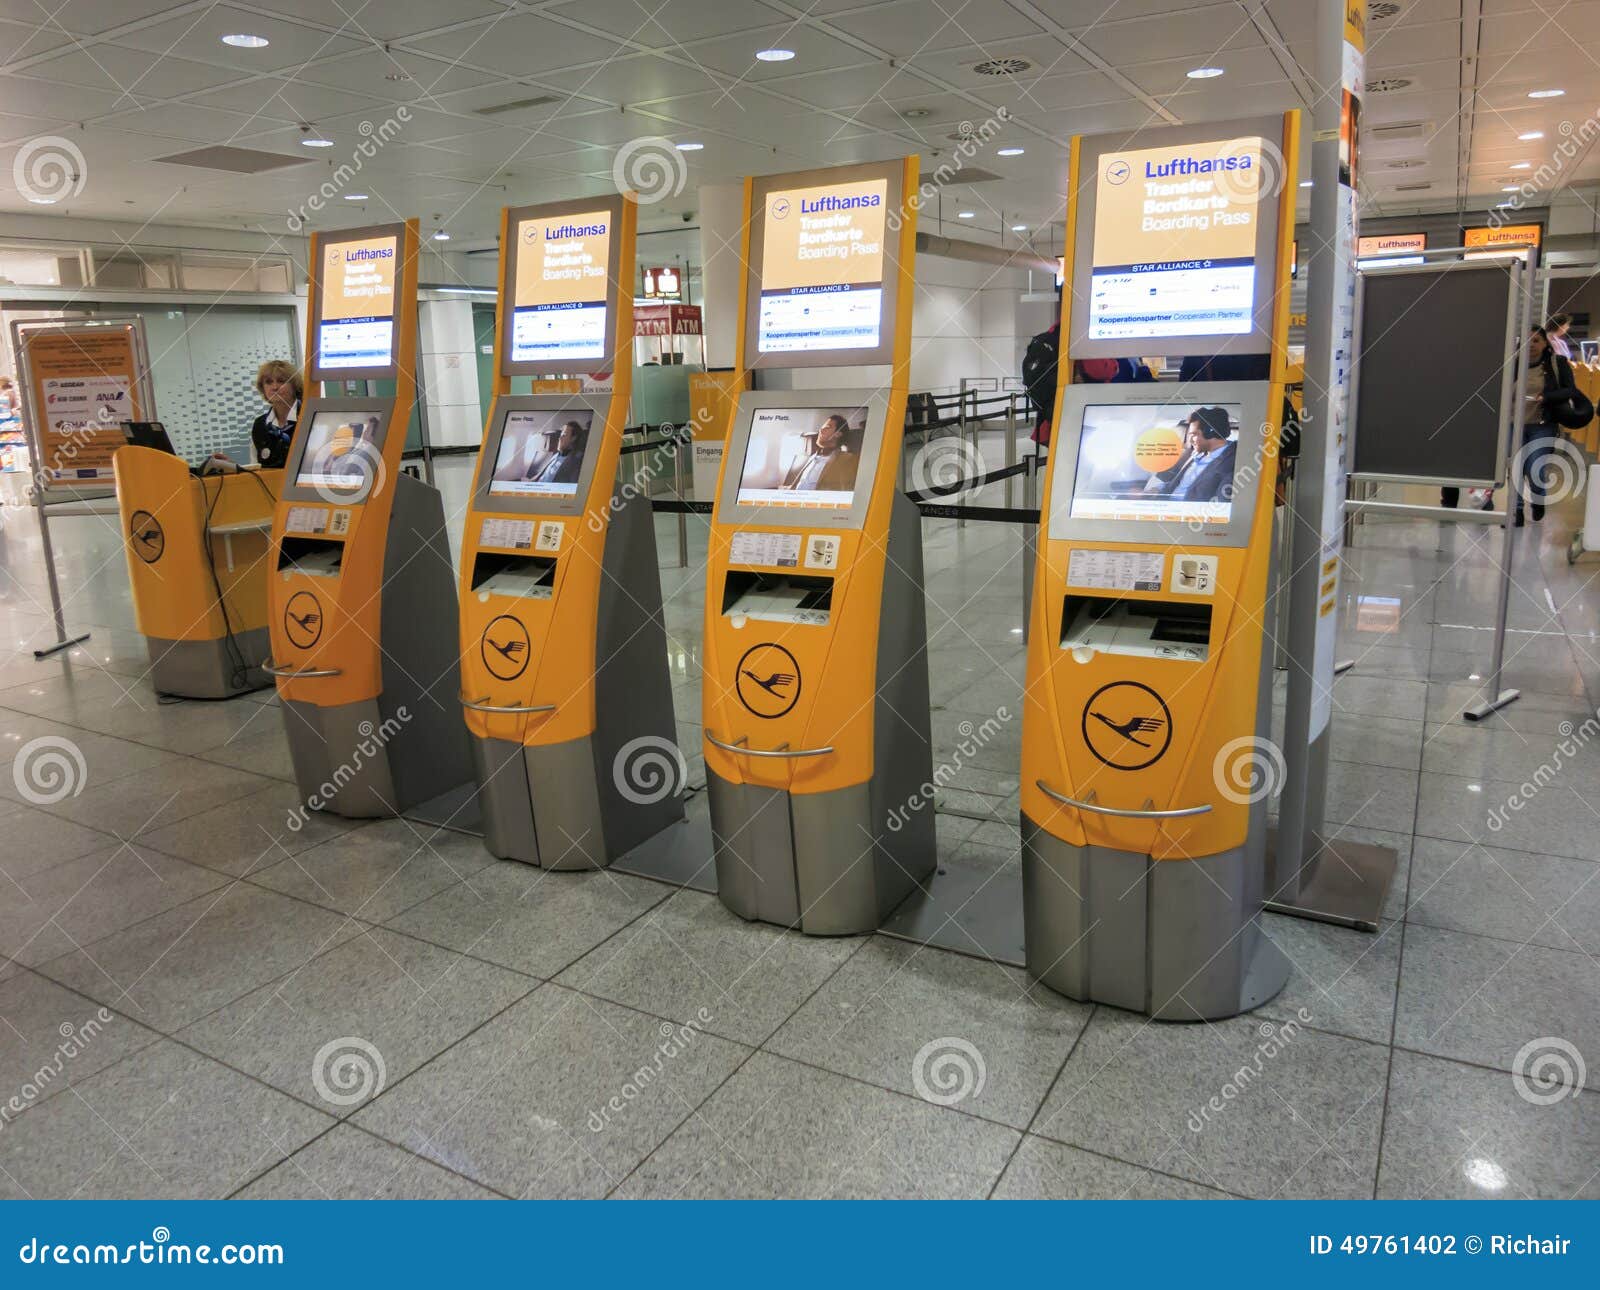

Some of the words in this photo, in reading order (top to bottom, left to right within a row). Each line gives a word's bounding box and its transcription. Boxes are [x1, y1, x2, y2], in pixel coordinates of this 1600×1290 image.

[1144, 154, 1252, 178] Lufthansa
[1144, 179, 1214, 197] Transfer
[801, 194, 881, 214] Lufthansa
[1143, 194, 1230, 215] Bordkarte
[799, 213, 853, 230] Transfer
[1141, 213, 1209, 232] Boarding
[1212, 210, 1251, 227] Pass
[546, 224, 606, 240] Lufthansa
[798, 228, 865, 245] Bordkarte
[1487, 231, 1536, 242] Lufthansa
[797, 245, 849, 261] Boarding
[851, 241, 880, 256] Pass
[1377, 239, 1421, 249] Lufthansa
[346, 247, 393, 262] Lufthansa
[1132, 264, 1155, 273] STAR
[1156, 261, 1201, 271] ALLIANCE
[791, 287, 808, 295] STAR
[809, 284, 842, 294] ALLIANCE
[1098, 314, 1172, 325] Kooperationspartner
[1173, 312, 1216, 322] Cooperation
[1217, 310, 1243, 320] Partner
[635, 320, 667, 336] ATM
[675, 319, 699, 334] ATM
[96, 392, 115, 402] ANA
[696, 446, 723, 457] Eingang
